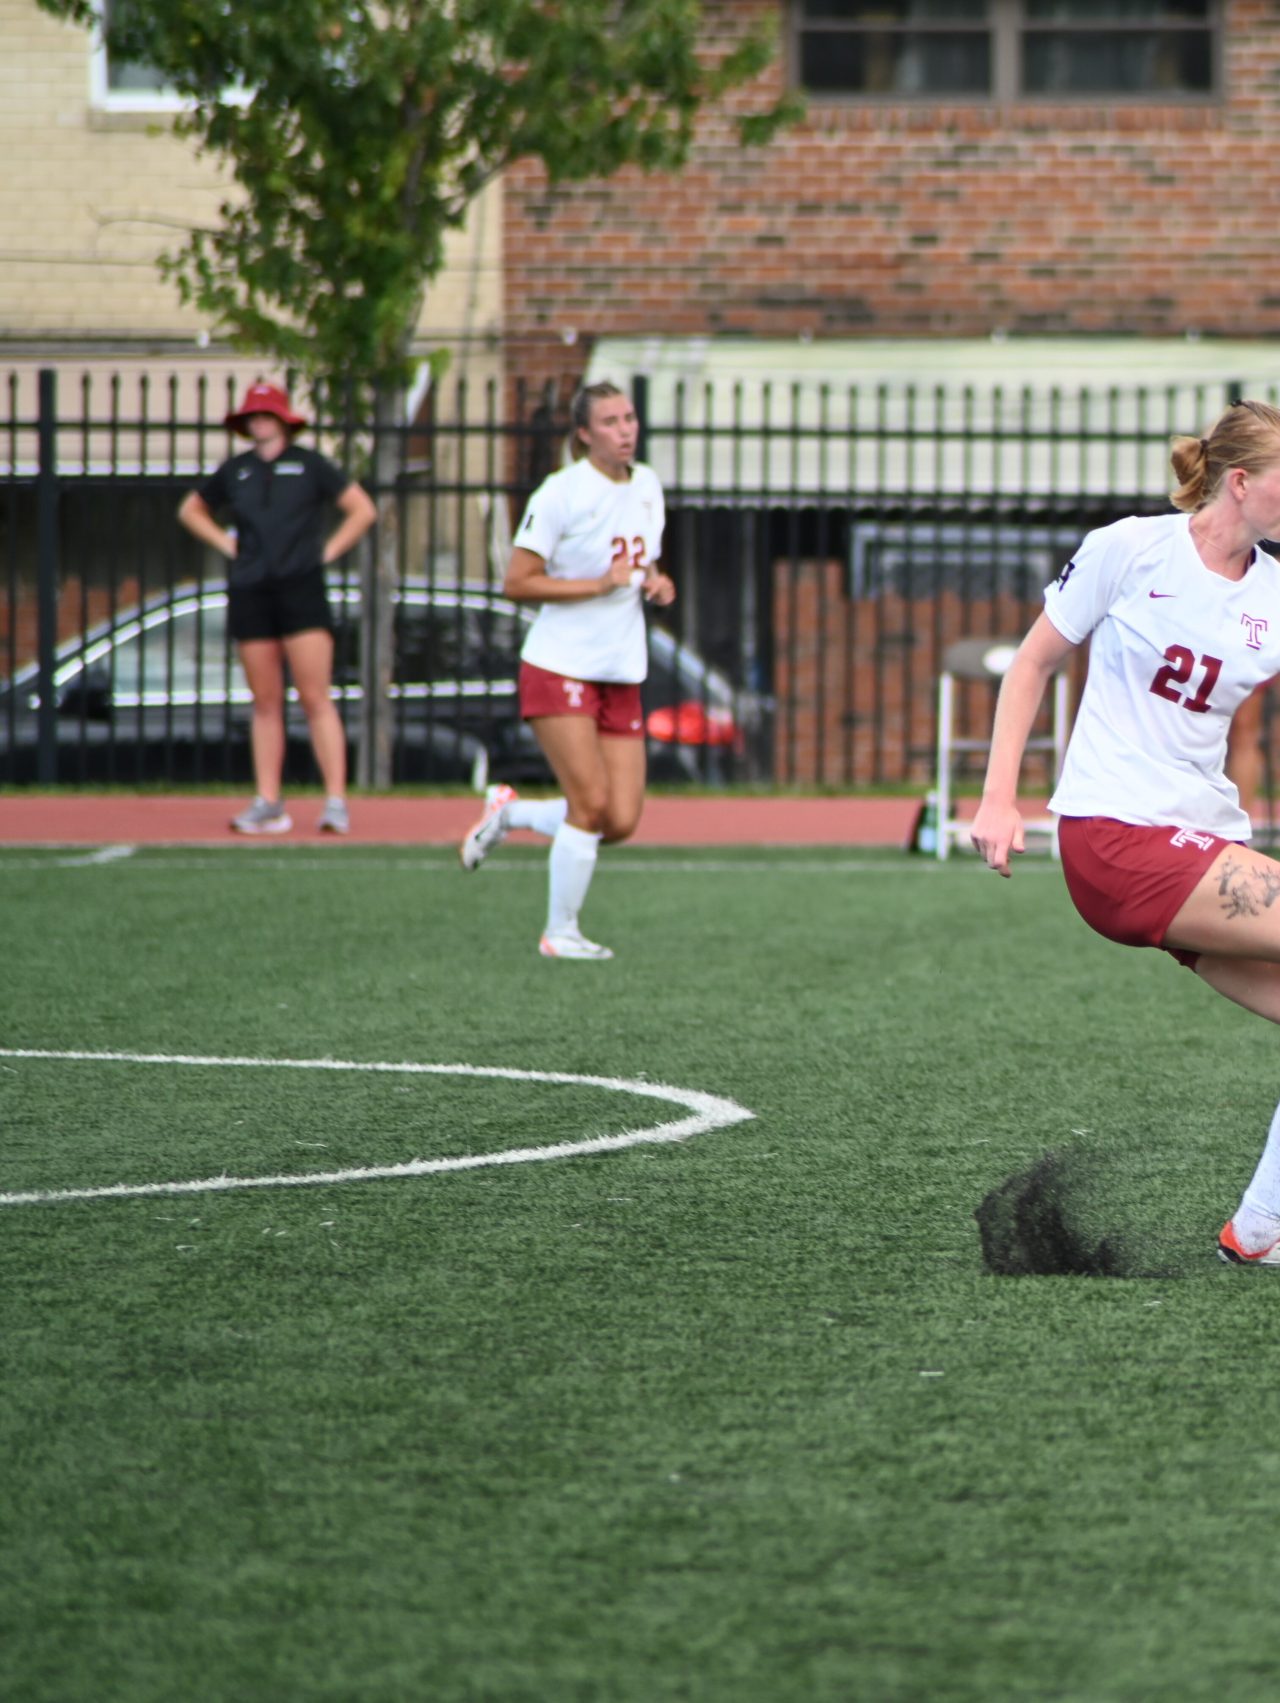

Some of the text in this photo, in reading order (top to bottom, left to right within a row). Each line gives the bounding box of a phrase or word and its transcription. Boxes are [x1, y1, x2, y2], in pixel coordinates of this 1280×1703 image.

[611, 536, 647, 569] 22
[1241, 613, 1268, 650] T
[1149, 643, 1223, 714] 21
